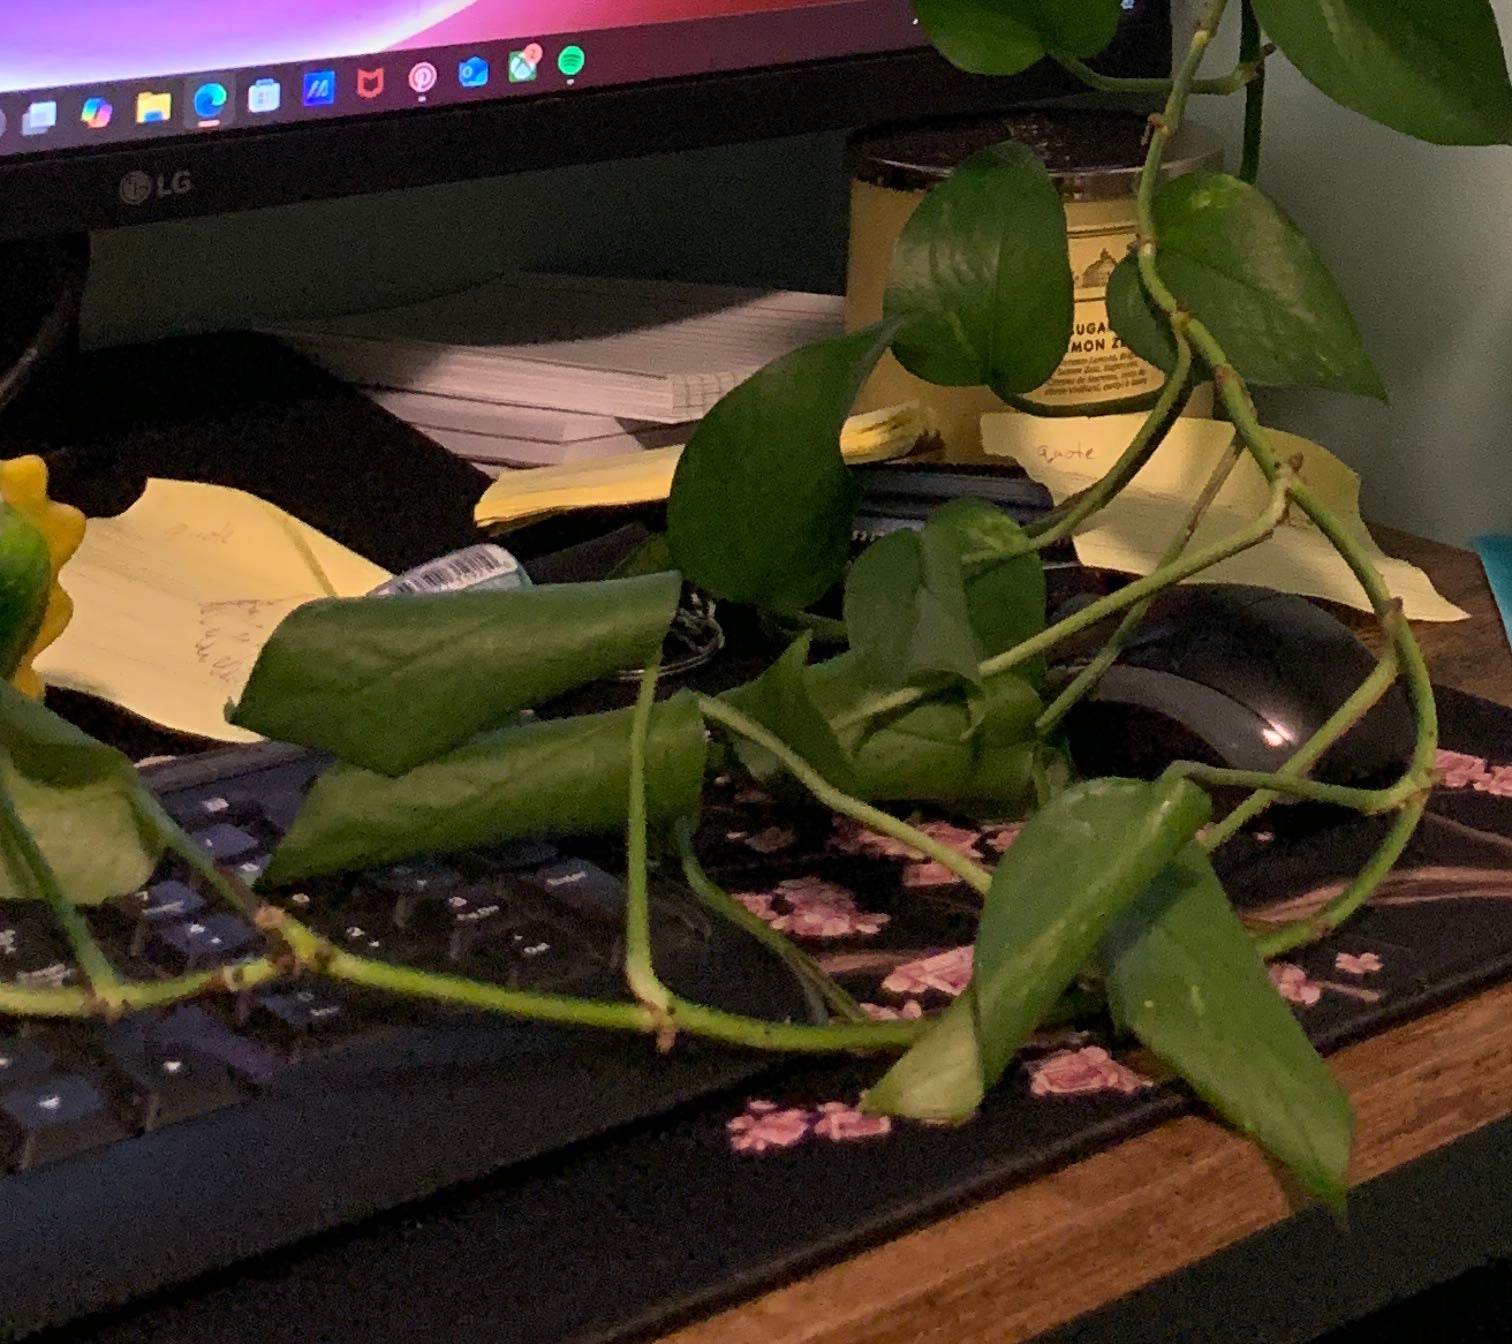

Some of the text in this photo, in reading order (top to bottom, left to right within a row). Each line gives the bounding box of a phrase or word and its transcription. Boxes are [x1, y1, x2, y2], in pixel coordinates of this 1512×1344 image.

[157, 170, 192, 198] LG
[1073, 321, 1107, 336] UGA
[1071, 338, 1106, 354] MON
